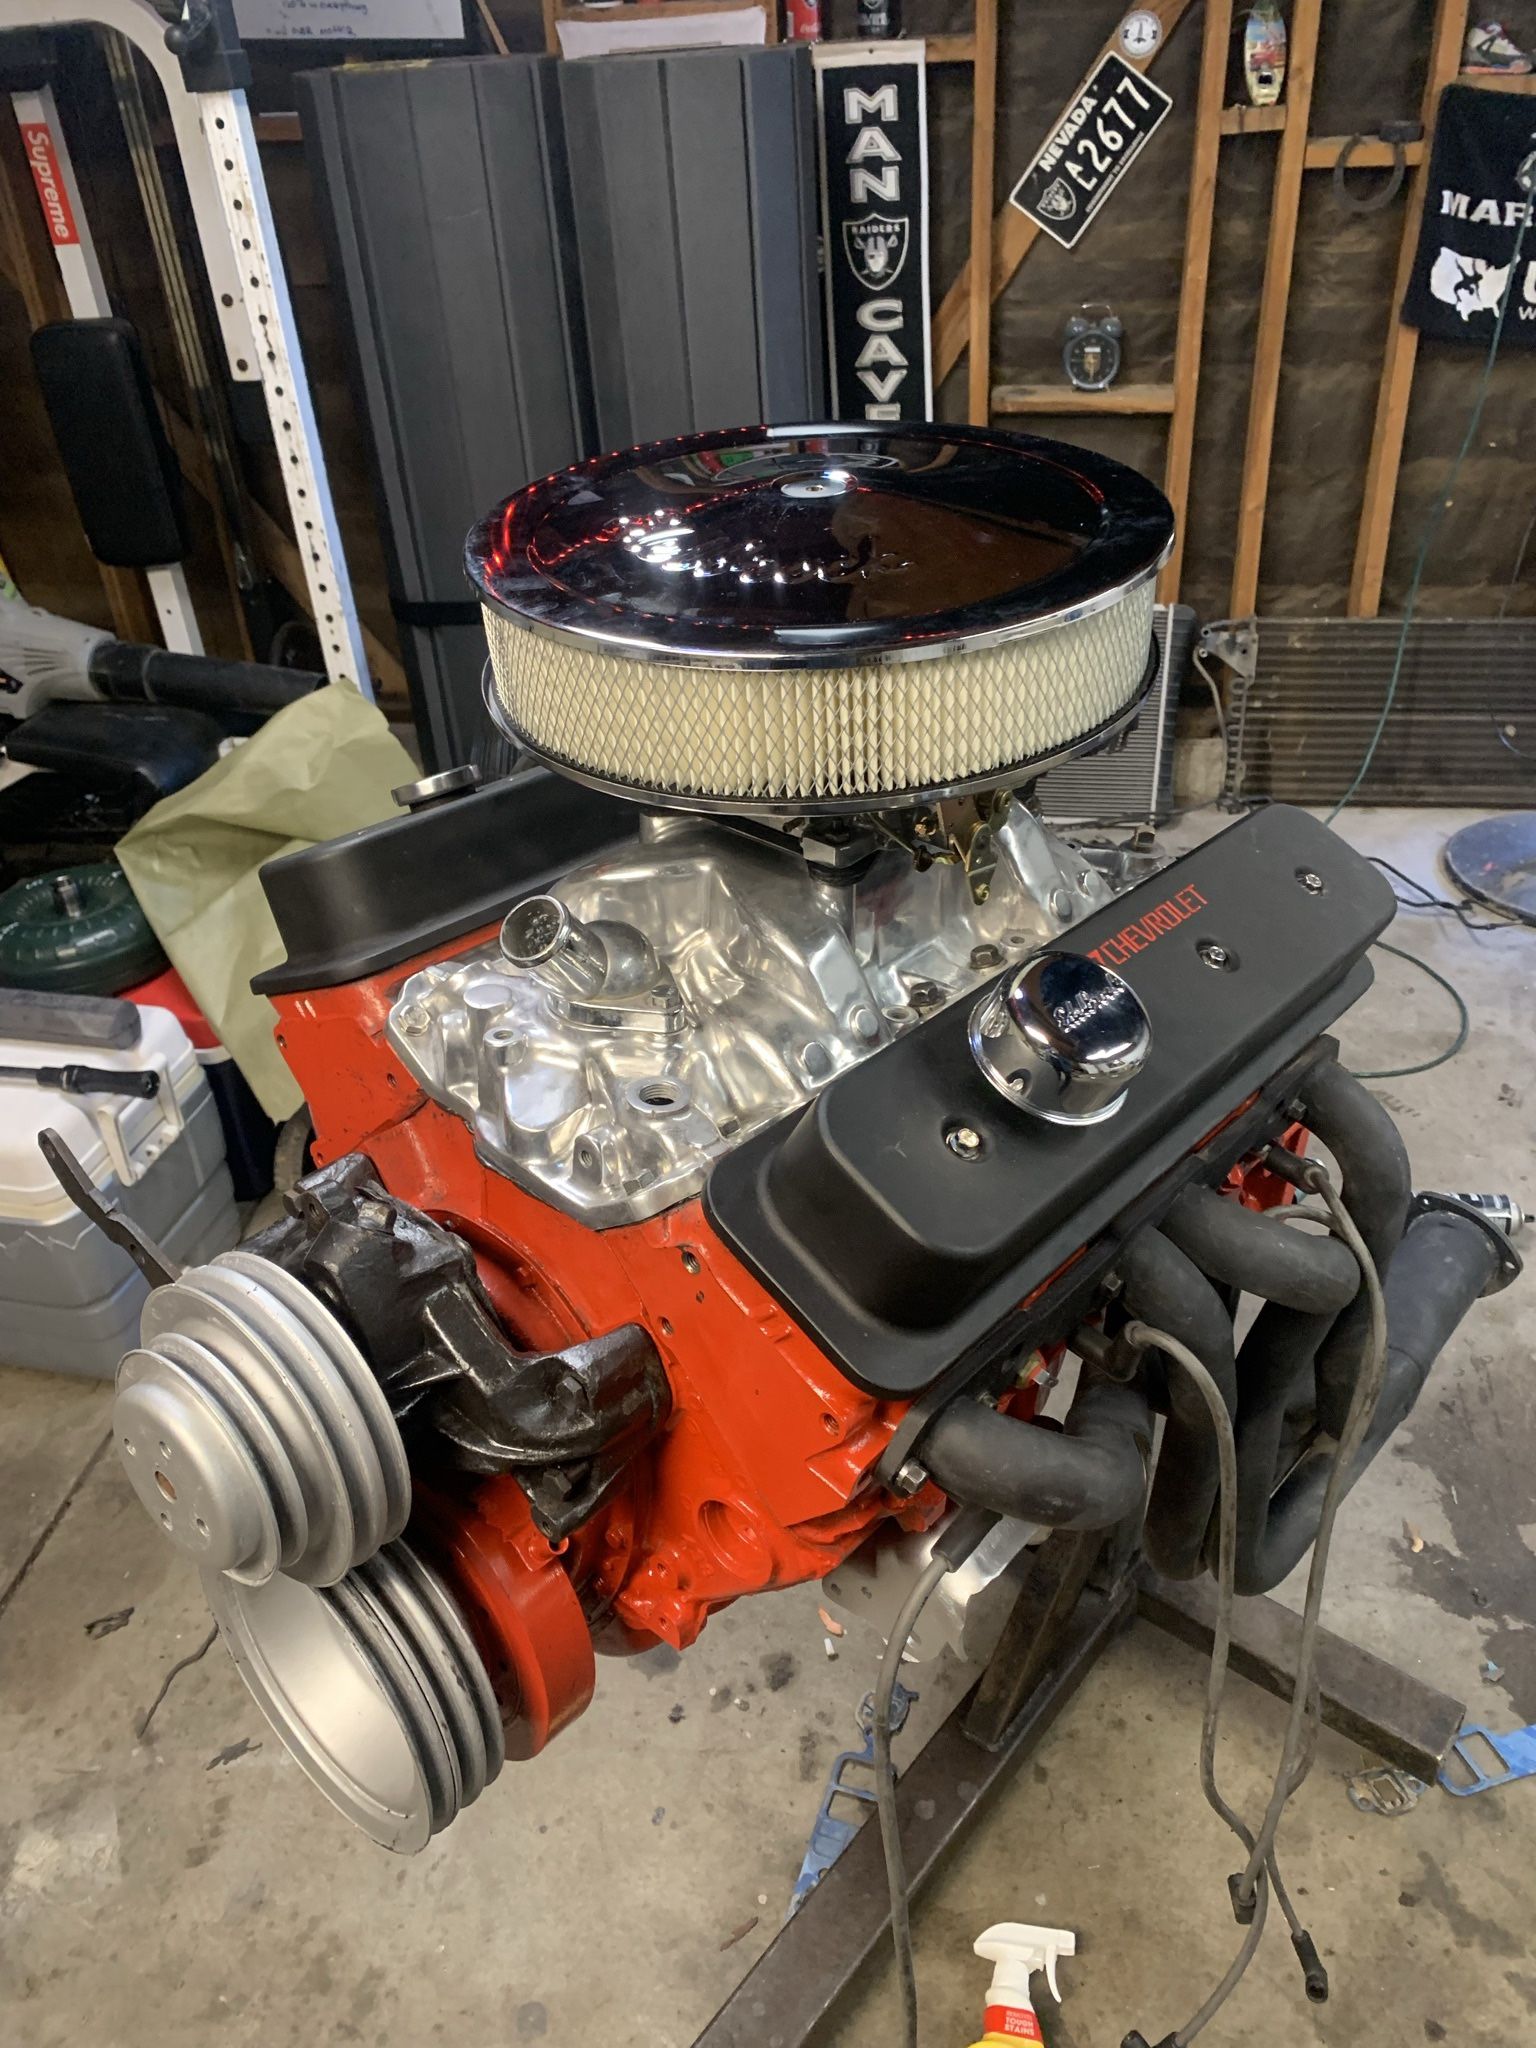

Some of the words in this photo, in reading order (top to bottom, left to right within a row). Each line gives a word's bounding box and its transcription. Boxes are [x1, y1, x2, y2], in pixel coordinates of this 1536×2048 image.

[844, 84, 902, 203] MAN
[1038, 96, 1098, 172] NEVADA
[28, 130, 69, 238] Supreme
[852, 223, 901, 233] RAIDERS
[1103, 884, 1208, 966] CHEVROLET
[1004, 2025, 1036, 2036] STAINS
[1005, 2017, 1034, 2028] TOUGH
